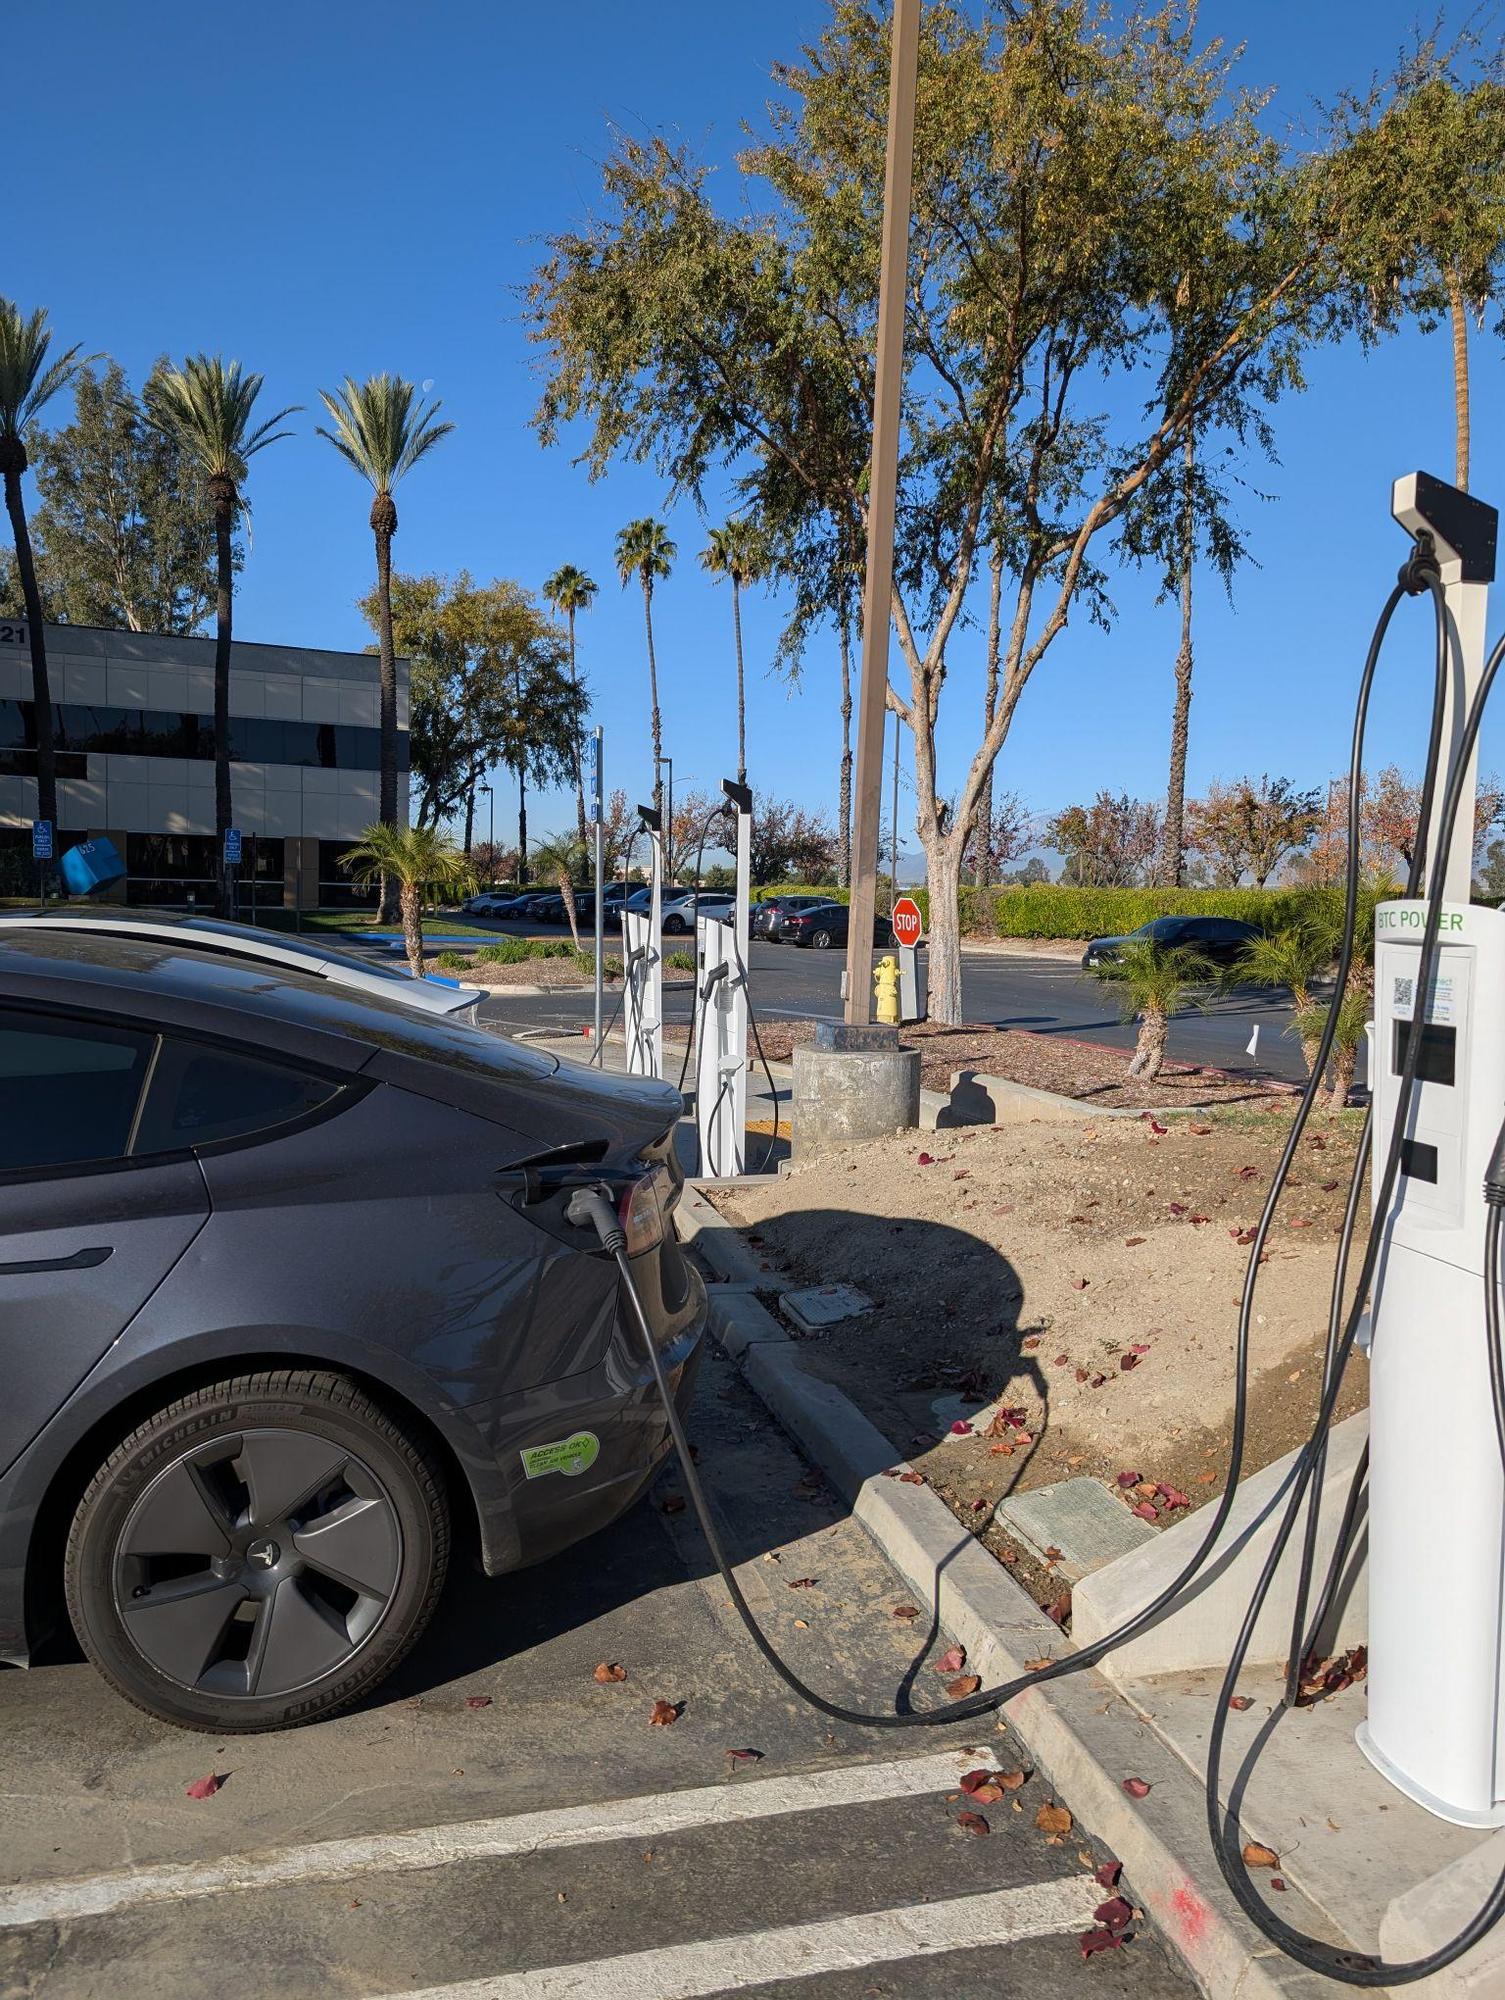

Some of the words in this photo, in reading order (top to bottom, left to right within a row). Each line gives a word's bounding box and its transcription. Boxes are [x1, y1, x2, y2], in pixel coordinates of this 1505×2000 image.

[897, 914, 917, 931] STOP
[1378, 911, 1397, 929] BTC
[1400, 911, 1464, 931] POER
[140, 1410, 233, 1469] MICHELIN
[531, 1444, 567, 1459] ACCESS
